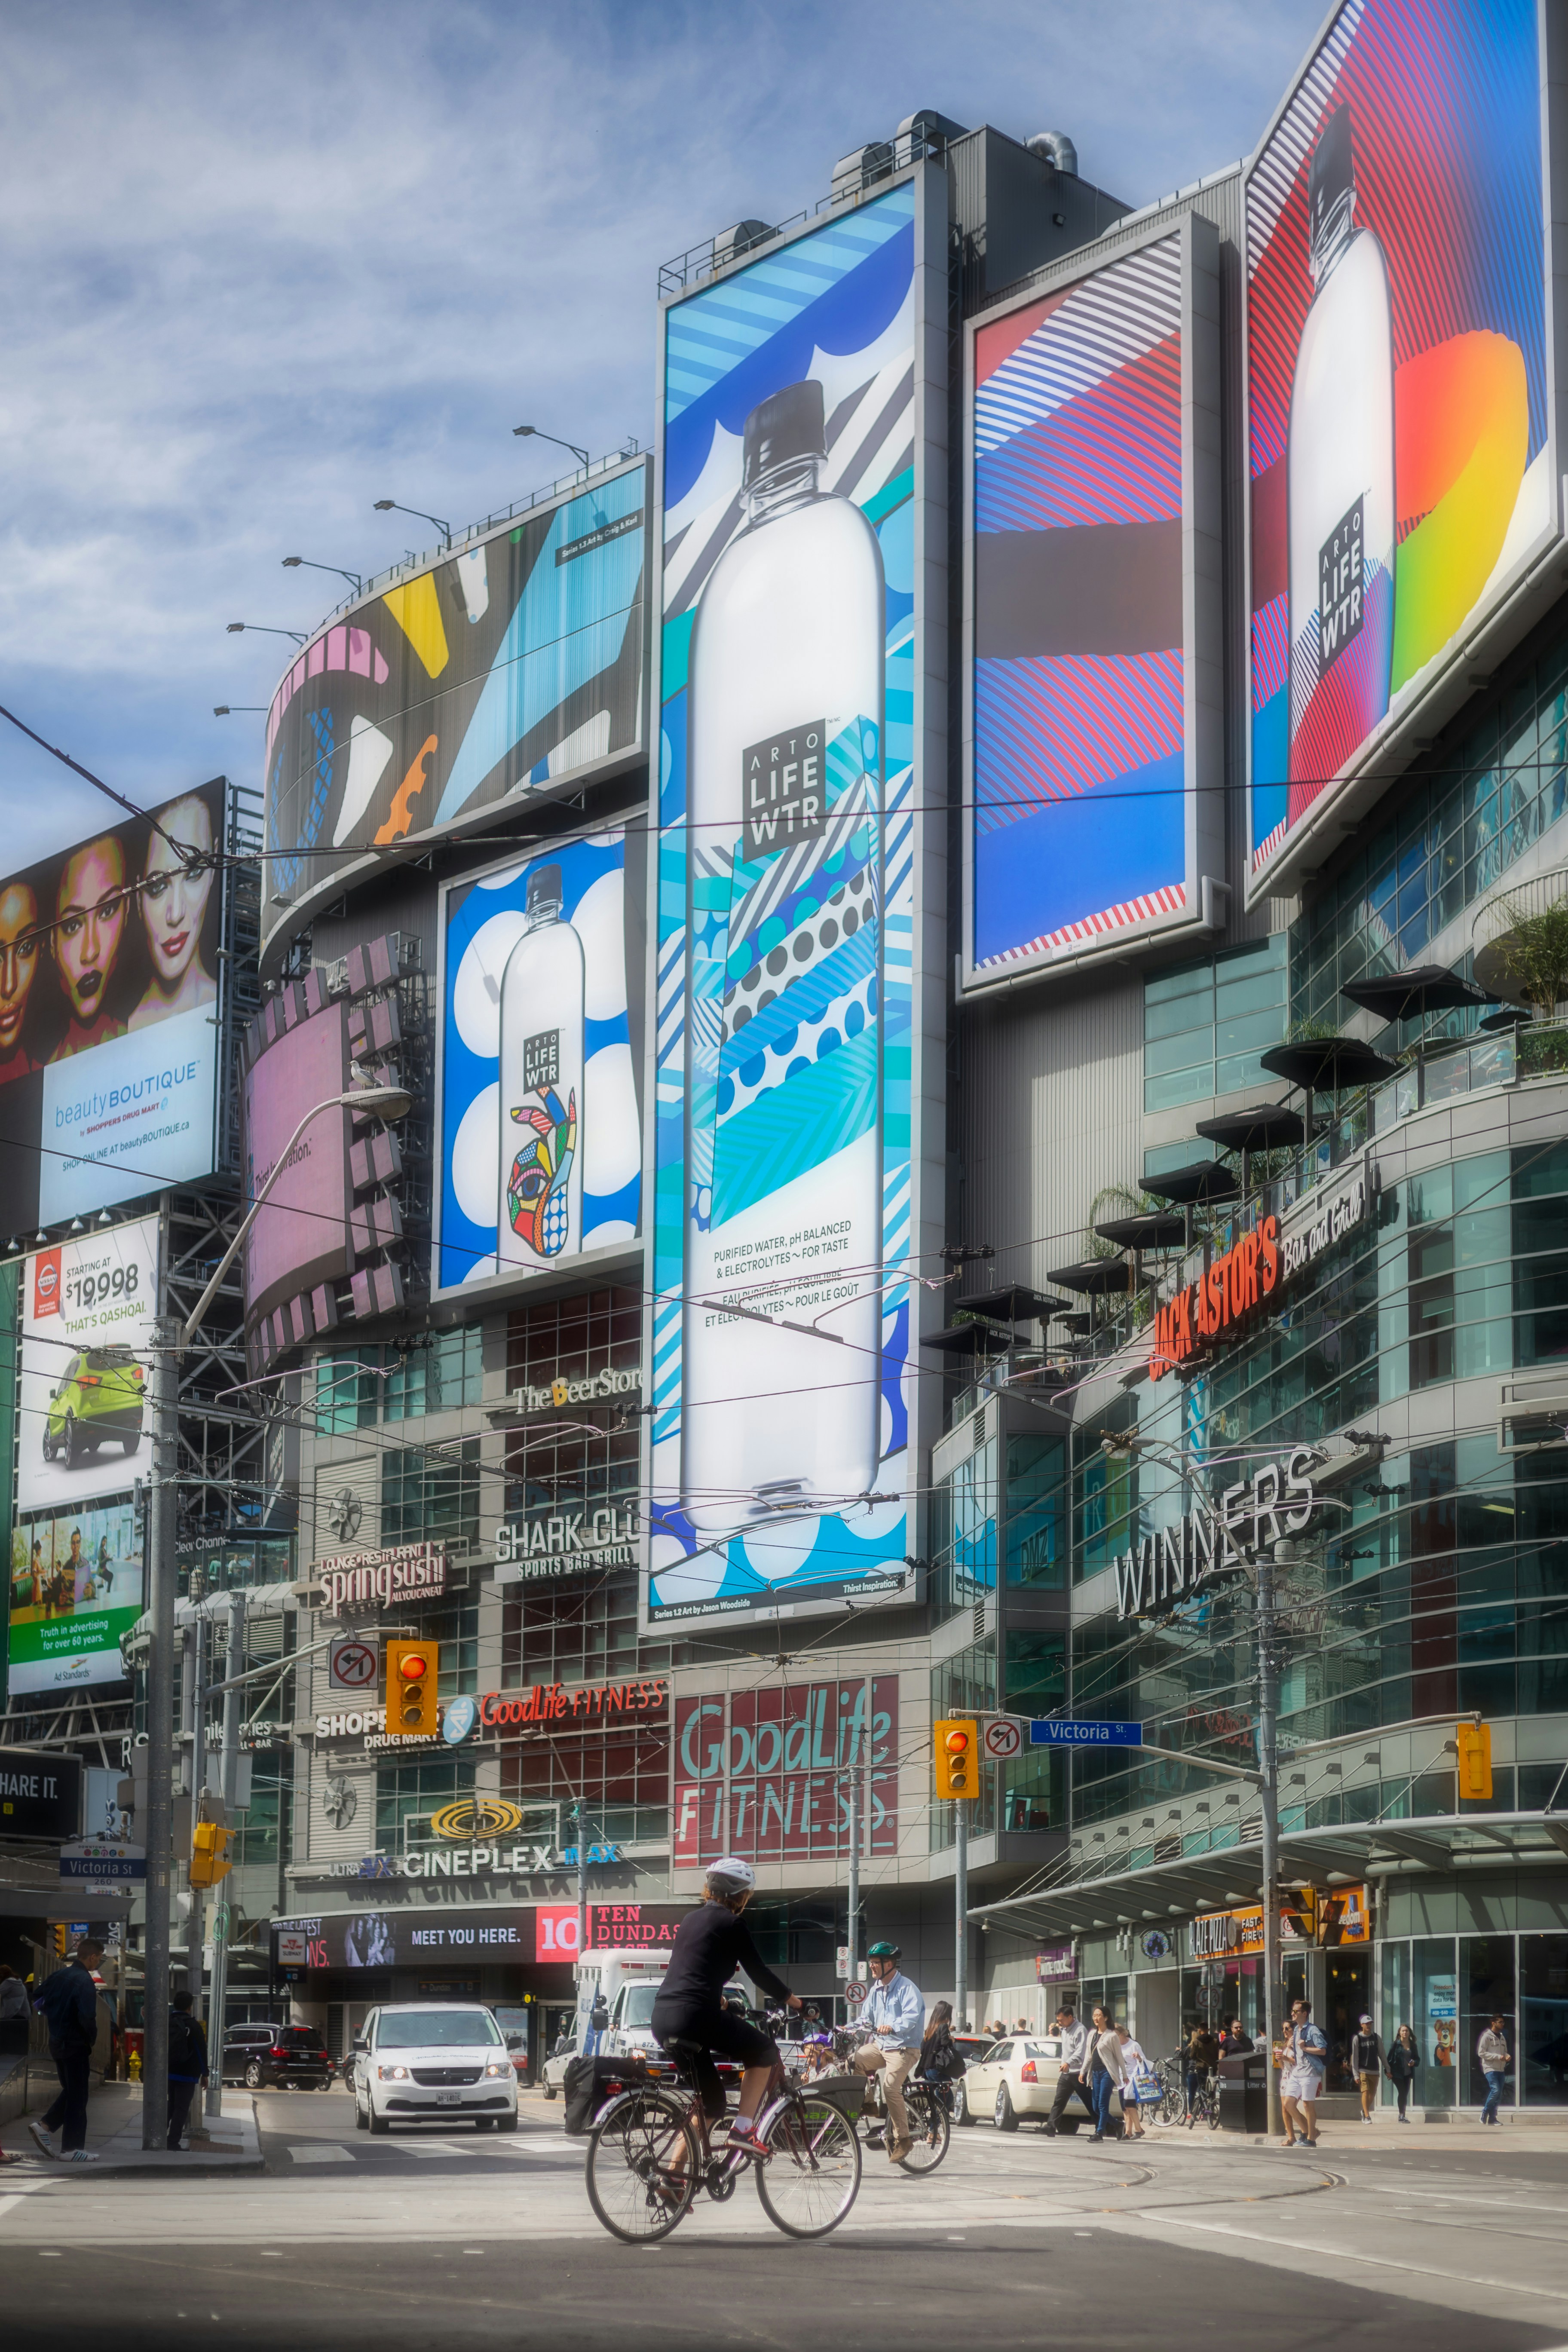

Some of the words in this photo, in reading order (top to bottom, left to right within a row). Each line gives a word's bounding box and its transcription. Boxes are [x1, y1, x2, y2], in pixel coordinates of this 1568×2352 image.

[562, 546, 578, 557] Series
[587, 536, 596, 545] Art
[604, 525, 619, 537] Craig
[625, 515, 637, 527] Karl
[1323, 538, 1360, 617] LIFE
[1322, 585, 1360, 658] WTR
[751, 755, 818, 808] LIFE
[750, 796, 819, 845] WTR
[527, 1045, 556, 1069] LIFE
[526, 1064, 557, 1087] WTR
[87, 1116, 121, 1134] SHOPPERS
[122, 1110, 140, 1121] DRUG
[141, 1102, 159, 1115] MART
[63, 1159, 81, 1171] SHOP
[83, 1148, 108, 1164] ONLINE
[110, 1144, 118, 1155] AT
[120, 1121, 189, 1152] beautyBOUTIQUE.ca
[255, 1166, 270, 1194] Thirst
[714, 1244, 753, 1262] PURIFIED
[755, 1236, 787, 1252] WATER,
[790, 1232, 801, 1247] pH
[804, 1220, 851, 1241] BALANCED
[1282, 1237, 1307, 1276] Bar
[1310, 1208, 1329, 1256] and
[1332, 1181, 1362, 1242] Grill
[67, 1261, 100, 1278] STARTING
[102, 1257, 110, 1267] AT
[717, 1268, 723, 1279] &
[725, 1252, 790, 1277] ELECTROLYTES
[802, 1245, 819, 1259] FOR
[822, 1238, 848, 1254] TASTE
[66, 1263, 138, 1308] $19,998
[723, 1293, 740, 1305] EAU
[1149, 1286, 1194, 1382] JACK
[1197, 1216, 1278, 1346] ASTOR'S
[65, 1314, 97, 1334] THAT'S
[100, 1301, 146, 1325] QASHQAI.
[706, 1315, 716, 1327] ET
[796, 1292, 819, 1308] POUR
[821, 1289, 831, 1302] LE
[833, 1283, 859, 1299] GOÛT
[513, 1385, 553, 1414] The
[551, 1377, 598, 1407] Beer
[495, 1512, 585, 1561] SHARK
[1113, 1445, 1312, 1622] WINNERS
[321, 1554, 356, 1572] LOUNGE
[362, 1543, 423, 1565] RESTAURANT
[518, 1556, 560, 1578] SPORTS
[567, 1552, 590, 1571] BAR
[596, 1547, 630, 1563] GRILL
[1021, 1526, 1047, 1579] DMZ
[843, 1583, 861, 1593] Thirst
[655, 1610, 673, 1619] Series
[683, 1607, 692, 1615] Art
[693, 1606, 701, 1615] by
[701, 1604, 719, 1613] Jason
[720, 1599, 750, 1610] Woodside
[40, 1626, 58, 1638] Truth
[61, 1625, 67, 1634] in
[69, 1620, 108, 1633] advertising
[43, 1641, 53, 1650] for
[55, 1638, 70, 1648] over
[72, 1635, 81, 1645] 60
[83, 1634, 104, 1646] years.
[54, 1672, 61, 1681] Ad
[63, 1668, 89, 1680] Standards
[481, 1682, 567, 1725] GoodLife
[573, 1679, 666, 1716] FITNESS
[256, 1739, 272, 1749] BAR
[364, 1734, 400, 1749] DRUG
[681, 1684, 891, 1779] GoodLife
[1050, 1723, 1109, 1739] Victoria
[43, 1776, 58, 1799] IT.
[679, 1773, 888, 1842] FITNESS
[70, 1861, 118, 1874] Victoria
[122, 1865, 132, 1874] St
[328, 1862, 360, 1877] ULTRA
[403, 1846, 553, 1877] CINEPLEX
[598, 1906, 640, 1922] TEN
[412, 1930, 444, 1945] MEET
[448, 1929, 475, 1944] YOU
[479, 1928, 521, 1943] HERE.
[542, 1917, 579, 1950] 10
[1189, 1920, 1207, 1956] BLAZE
[1210, 1917, 1227, 1952] PIZZA
